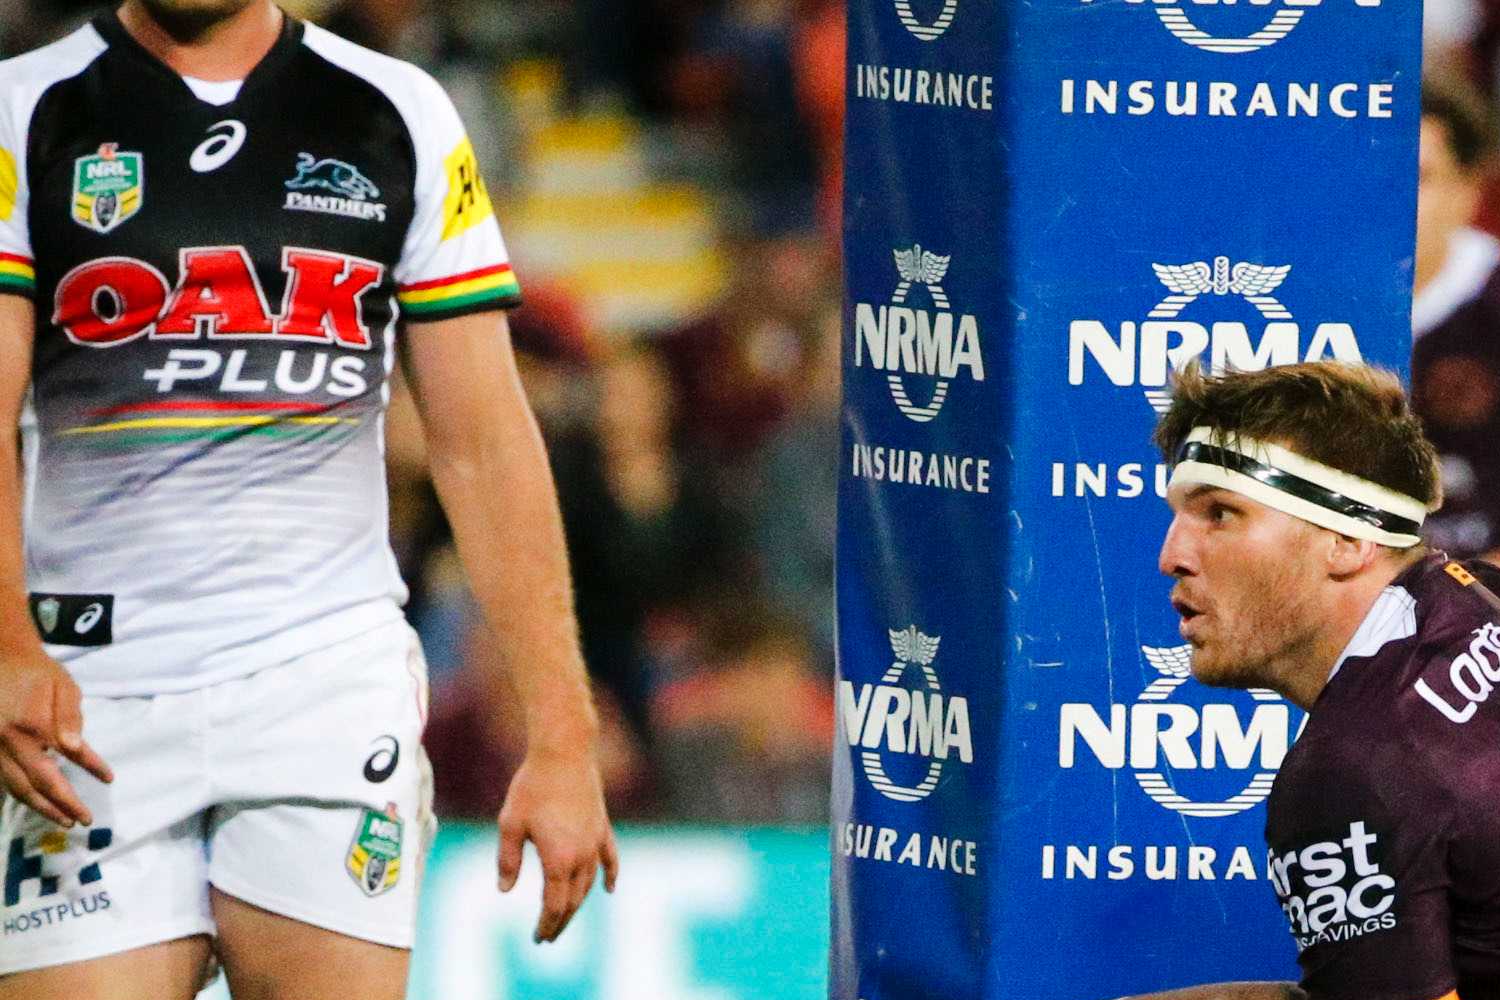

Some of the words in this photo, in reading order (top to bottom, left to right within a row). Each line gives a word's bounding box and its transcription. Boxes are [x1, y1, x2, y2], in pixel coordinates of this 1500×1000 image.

[856, 64, 993, 111] INSURANCE
[1060, 79, 1394, 118] INSURANCE
[86, 160, 133, 179] NRL
[282, 192, 388, 223] PANTHERS
[50, 245, 385, 349] OAK
[855, 302, 985, 382] NRMA
[143, 349, 368, 398] PLUS
[852, 443, 991, 494] INSURANCE
[1059, 703, 1310, 769] NRM
[1042, 845, 1276, 880] INSURA
[3, 891, 112, 936] HOSTPLUS
